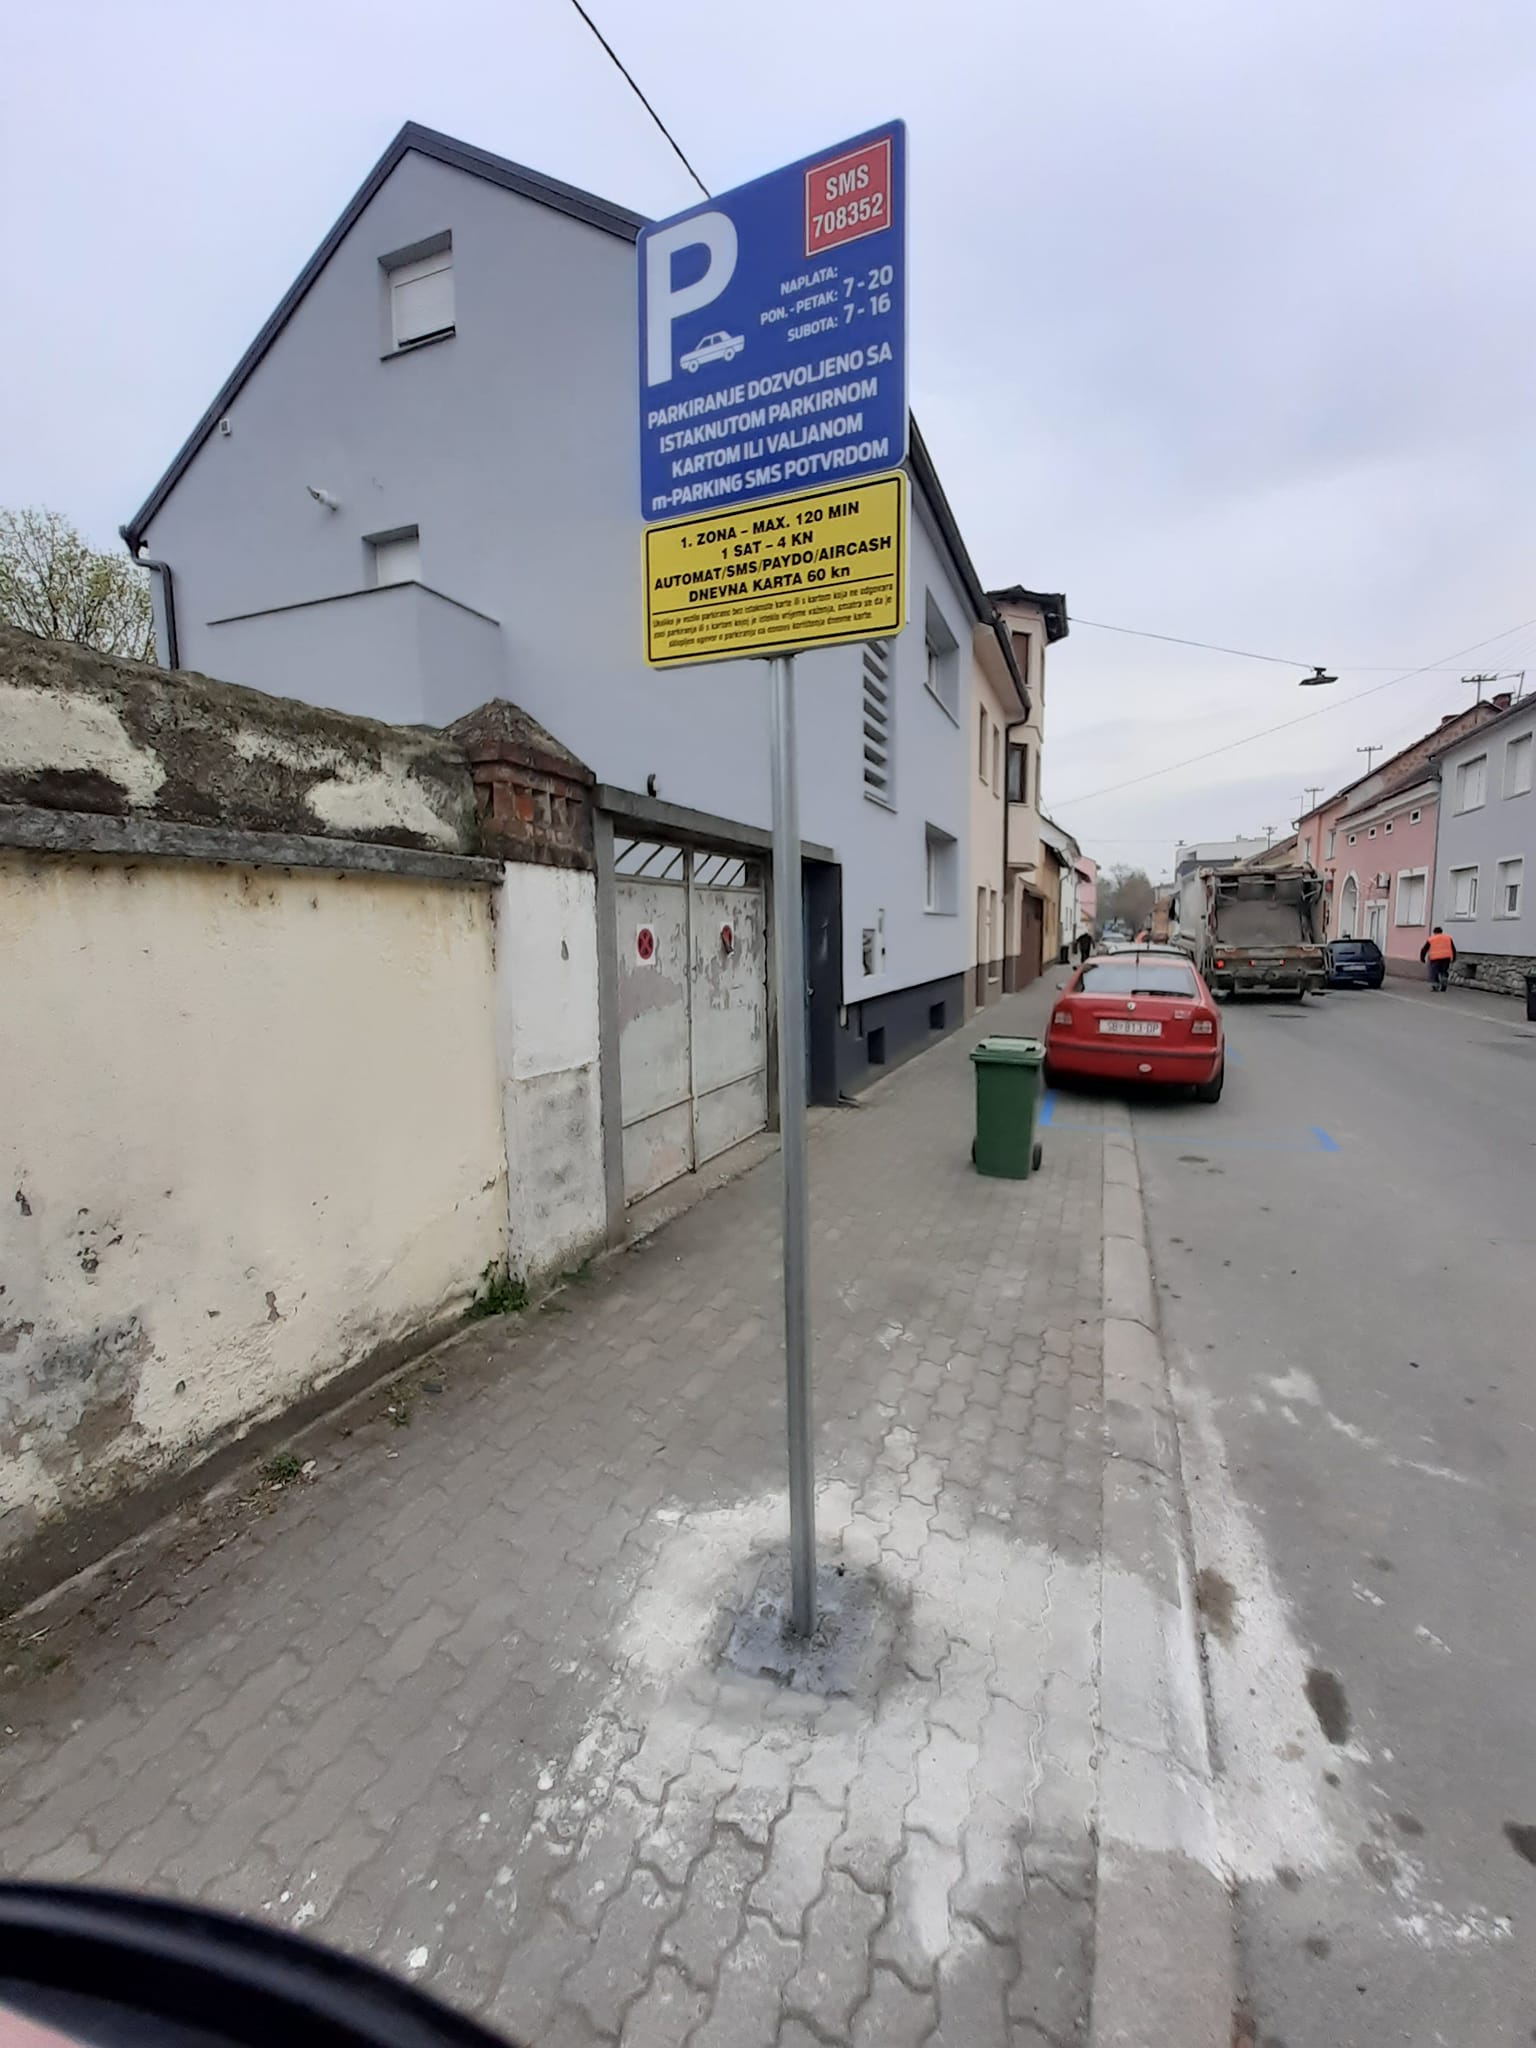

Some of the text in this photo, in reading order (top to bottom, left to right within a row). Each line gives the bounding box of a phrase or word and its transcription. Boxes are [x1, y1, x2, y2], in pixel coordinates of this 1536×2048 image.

[825, 163, 869, 201] SMS
[812, 192, 884, 239] 708352
[646, 211, 738, 387] P
[780, 266, 838, 296] NAPLATA:
[843, 277, 855, 298] 7
[867, 265, 894, 290] 20
[787, 316, 838, 342] SUBOTA:
[843, 303, 855, 324] 7
[869, 292, 891, 316] 16
[648, 341, 893, 430] PARKIRANJE DOZVOLJENO SA
[660, 376, 878, 454] ISTAKNUTOM PARKIRNOM
[672, 412, 863, 479] KARTOM ILI VALJANOM
[651, 437, 889, 512] m-PARKING SMS POTVRDOM
[681, 537, 692, 548] 1.
[696, 526, 737, 546] ZONA
[752, 515, 790, 535] MAX.
[796, 509, 823, 525] 120
[828, 501, 859, 519] MIN
[721, 548, 728, 560] 1
[734, 540, 762, 557] SAT
[777, 536, 786, 548] 4
[791, 530, 813, 546] KN
[654, 535, 891, 590] AUTOMAT/SMS/PAYDO/AIRCASH
[689, 566, 850, 602] DNEVNA KARTA 60 kn
